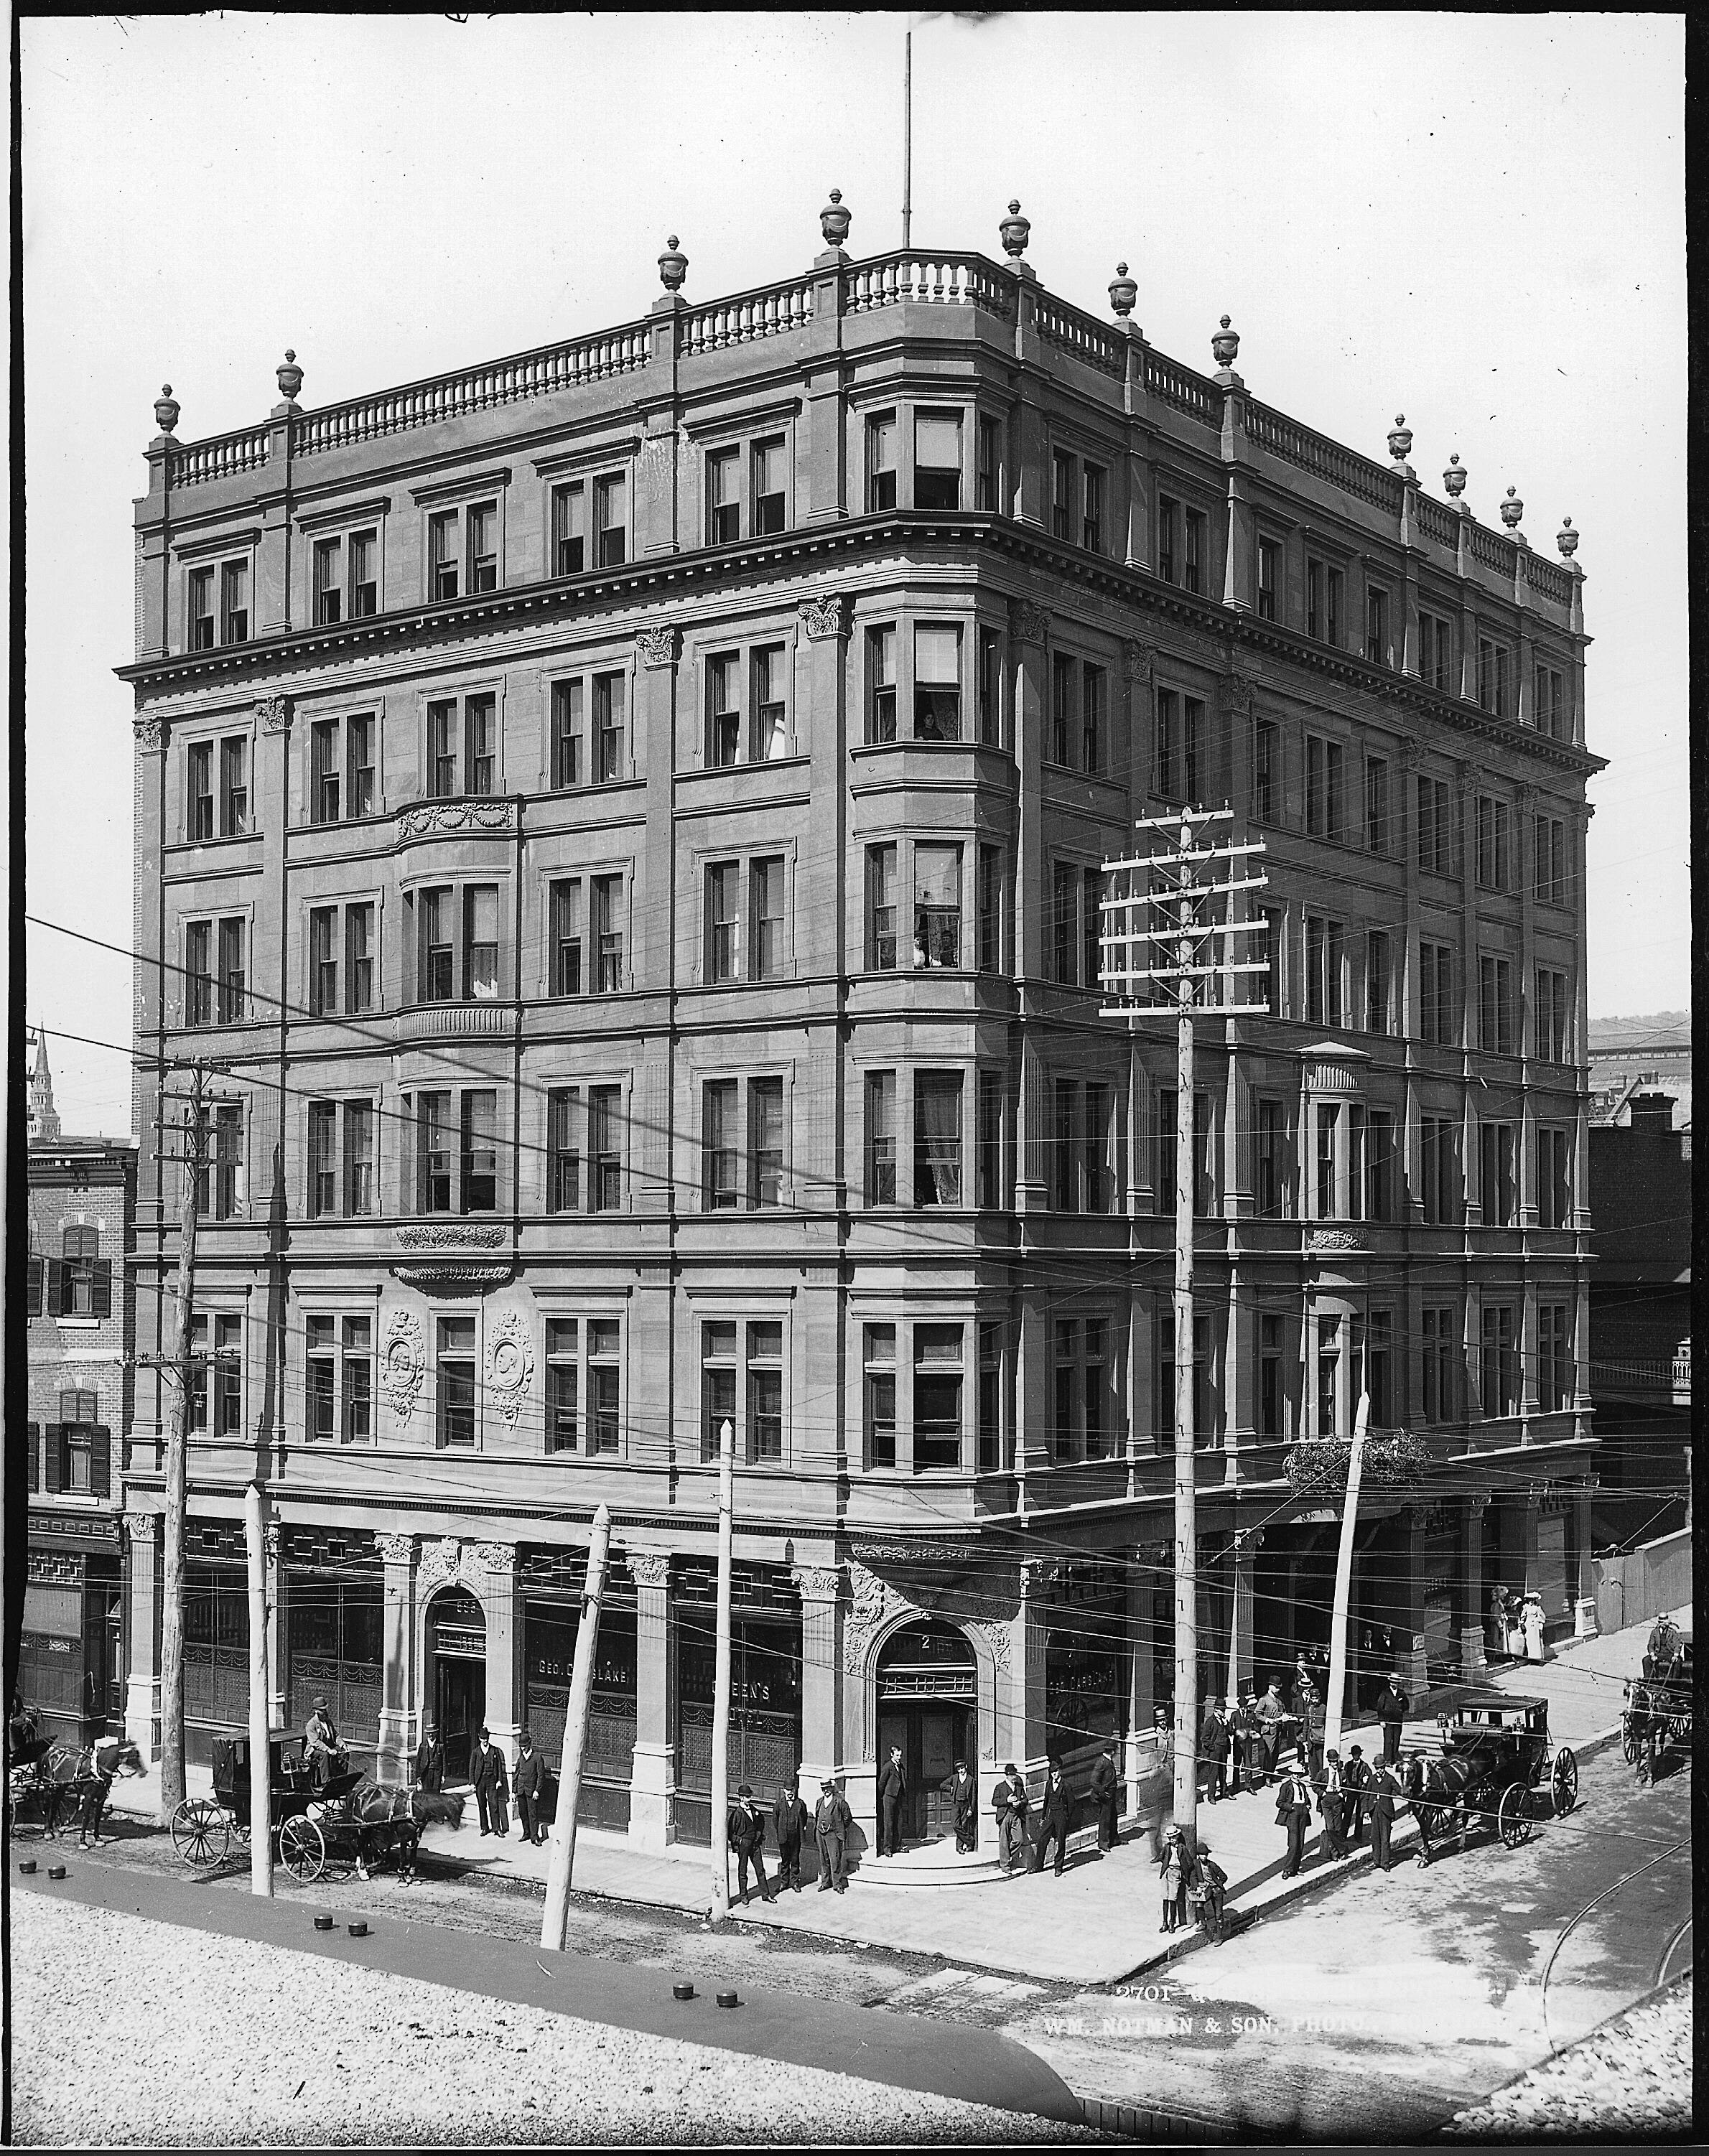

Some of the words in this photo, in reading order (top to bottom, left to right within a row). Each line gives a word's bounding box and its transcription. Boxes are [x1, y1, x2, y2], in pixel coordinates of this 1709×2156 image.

[921, 1635, 930, 1648] 2
[539, 1659, 564, 1676] GEO.
[567, 1663, 626, 1683] CSLAKE
[712, 1679, 770, 1700] EEN'S
[729, 1701, 763, 1725] OTEL
